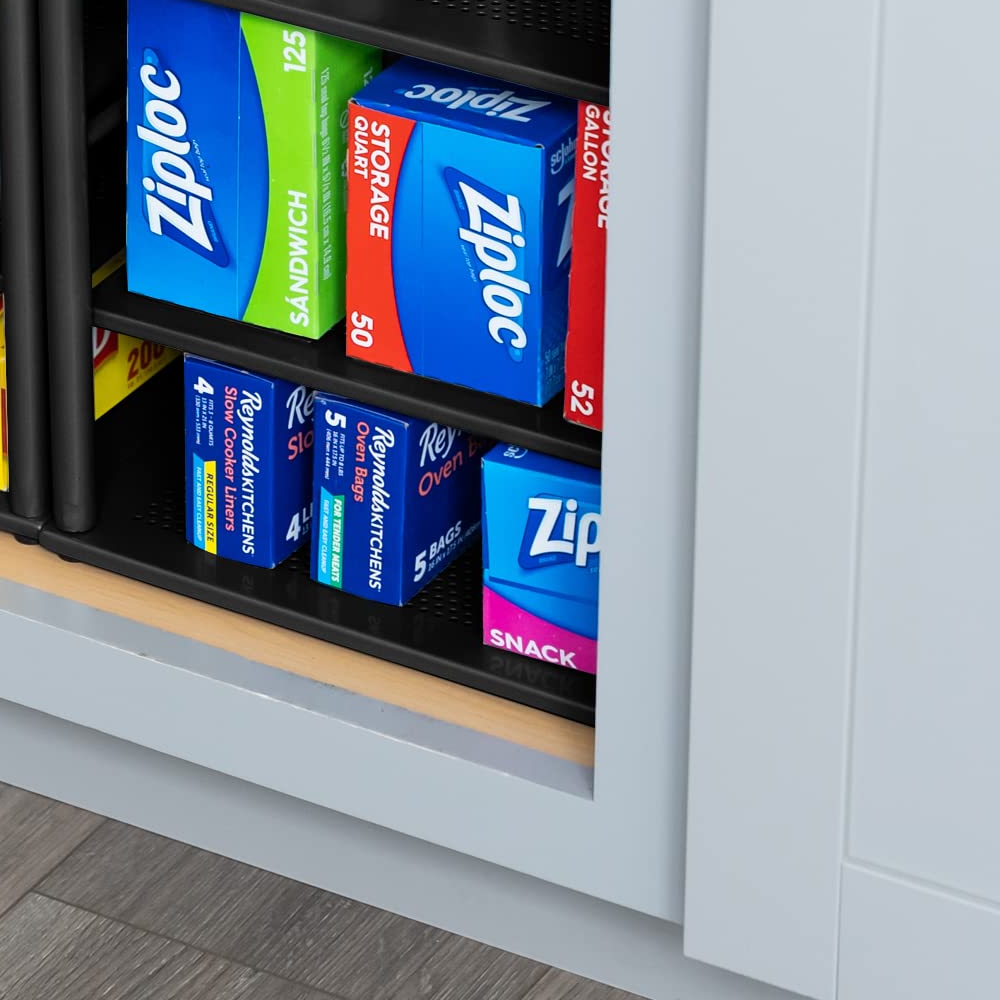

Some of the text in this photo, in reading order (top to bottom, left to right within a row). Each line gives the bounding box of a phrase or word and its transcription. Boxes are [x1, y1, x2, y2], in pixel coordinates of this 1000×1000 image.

[283, 29, 307, 73] 125
[402, 83, 552, 123] Ziploc
[137, 63, 213, 252] Ziploc
[353, 116, 369, 179] QUART
[583, 105, 599, 181] GALLON
[369, 120, 391, 240] STORAGE
[458, 180, 532, 350] Ziploc
[351, 311, 374, 348] 50
[193, 376, 215, 395] 4
[571, 379, 594, 417] 52
[287, 431, 313, 460] Slo
[325, 410, 347, 429] 5
[224, 386, 238, 532] Slow Cooker Liners
[351, 421, 370, 503] Oven Bags
[418, 450, 463, 496] Oven
[206, 473, 214, 542] REGULAR SIZE
[286, 513, 300, 542] 4
[528, 497, 601, 567] Zip
[331, 498, 342, 582] FOR TENDER MEATS
[414, 550, 426, 582] 5
[429, 520, 462, 560] BAGS
[490, 628, 577, 669] SNACK
